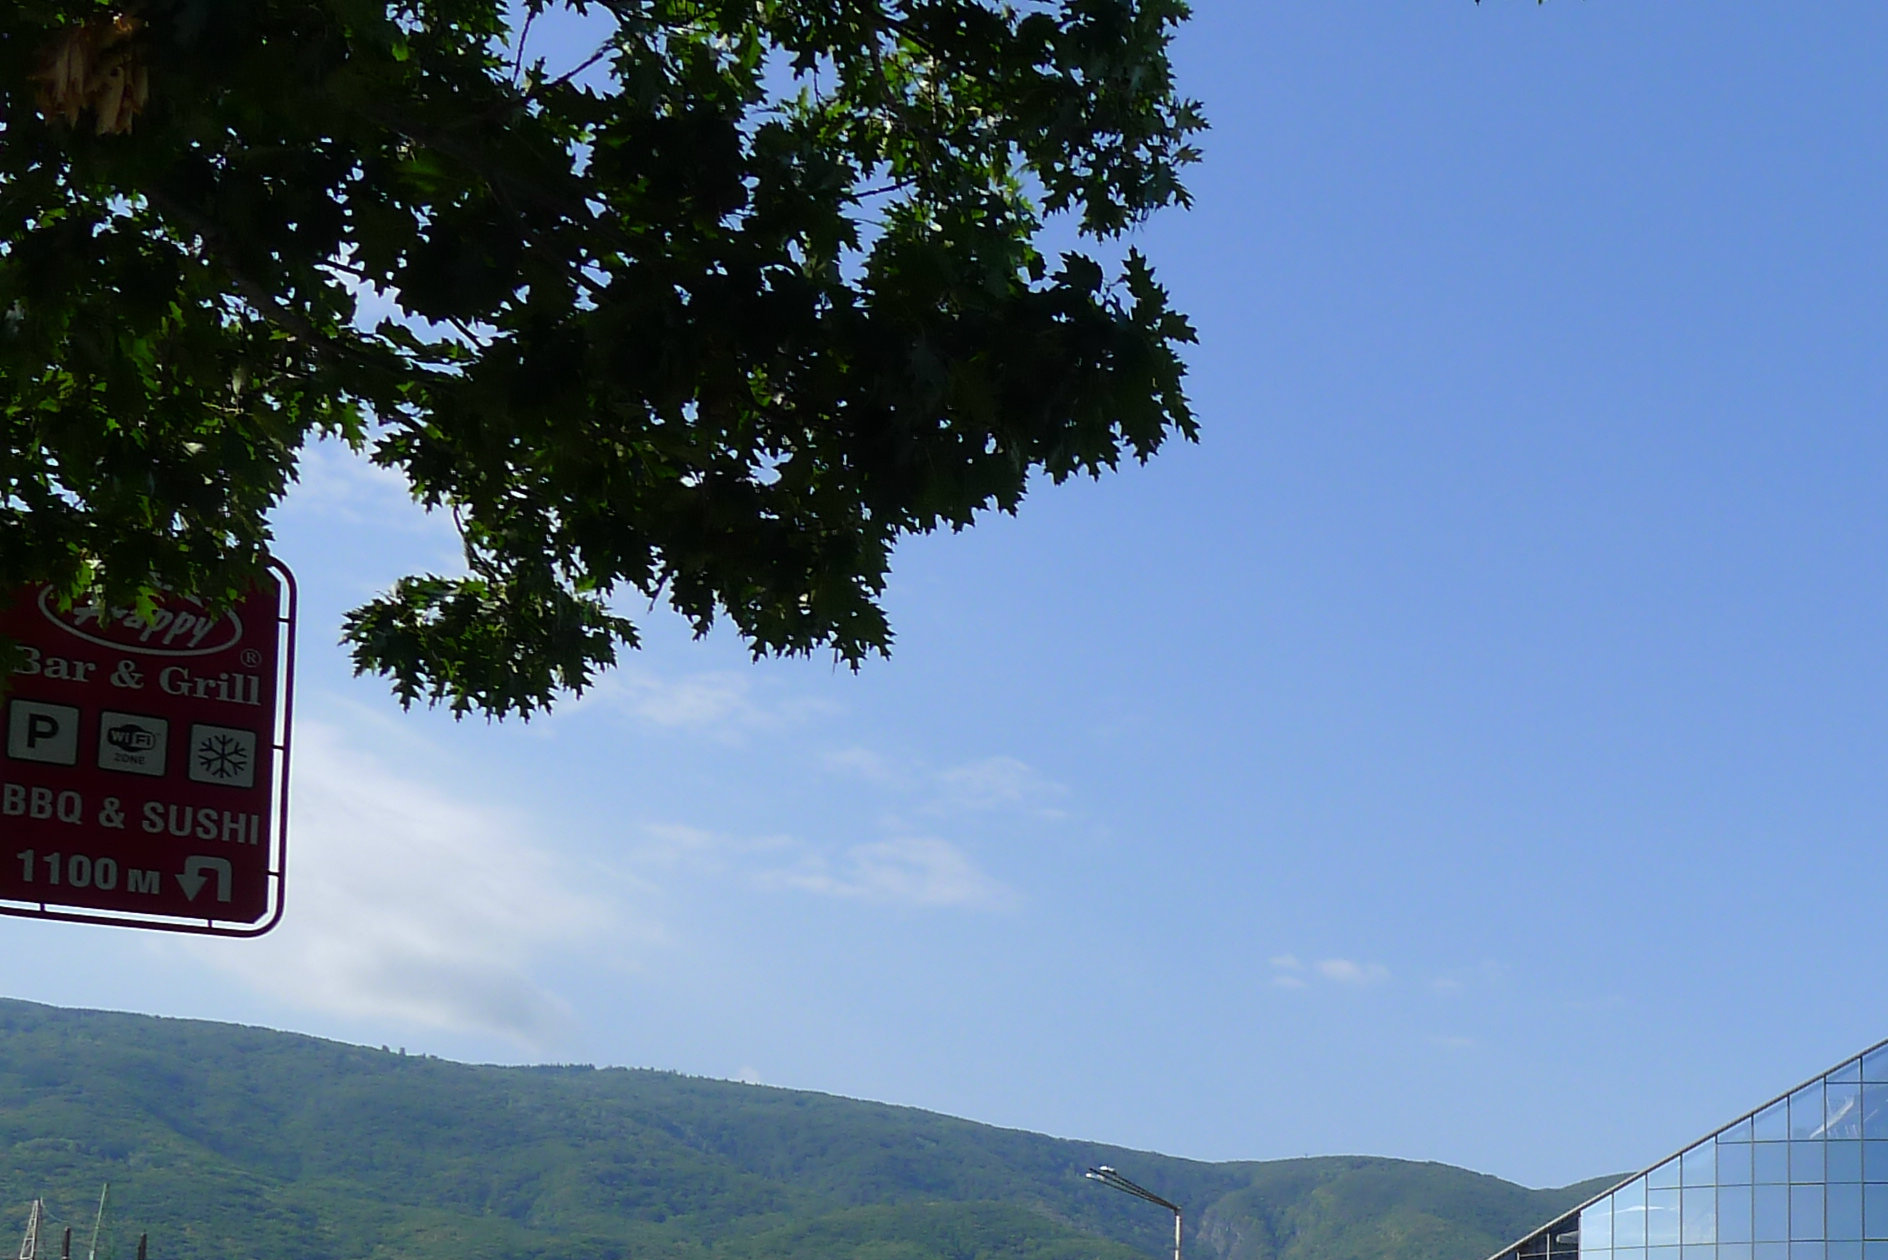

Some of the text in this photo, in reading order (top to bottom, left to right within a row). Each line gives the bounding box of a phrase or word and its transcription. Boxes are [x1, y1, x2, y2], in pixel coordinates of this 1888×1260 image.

[11, 645, 262, 706] Bar & Grill
[26, 712, 60, 749] P
[113, 752, 146, 766] ZONE
[2, 783, 260, 846] BBQ & SUSHI
[16, 849, 118, 891] 1100
